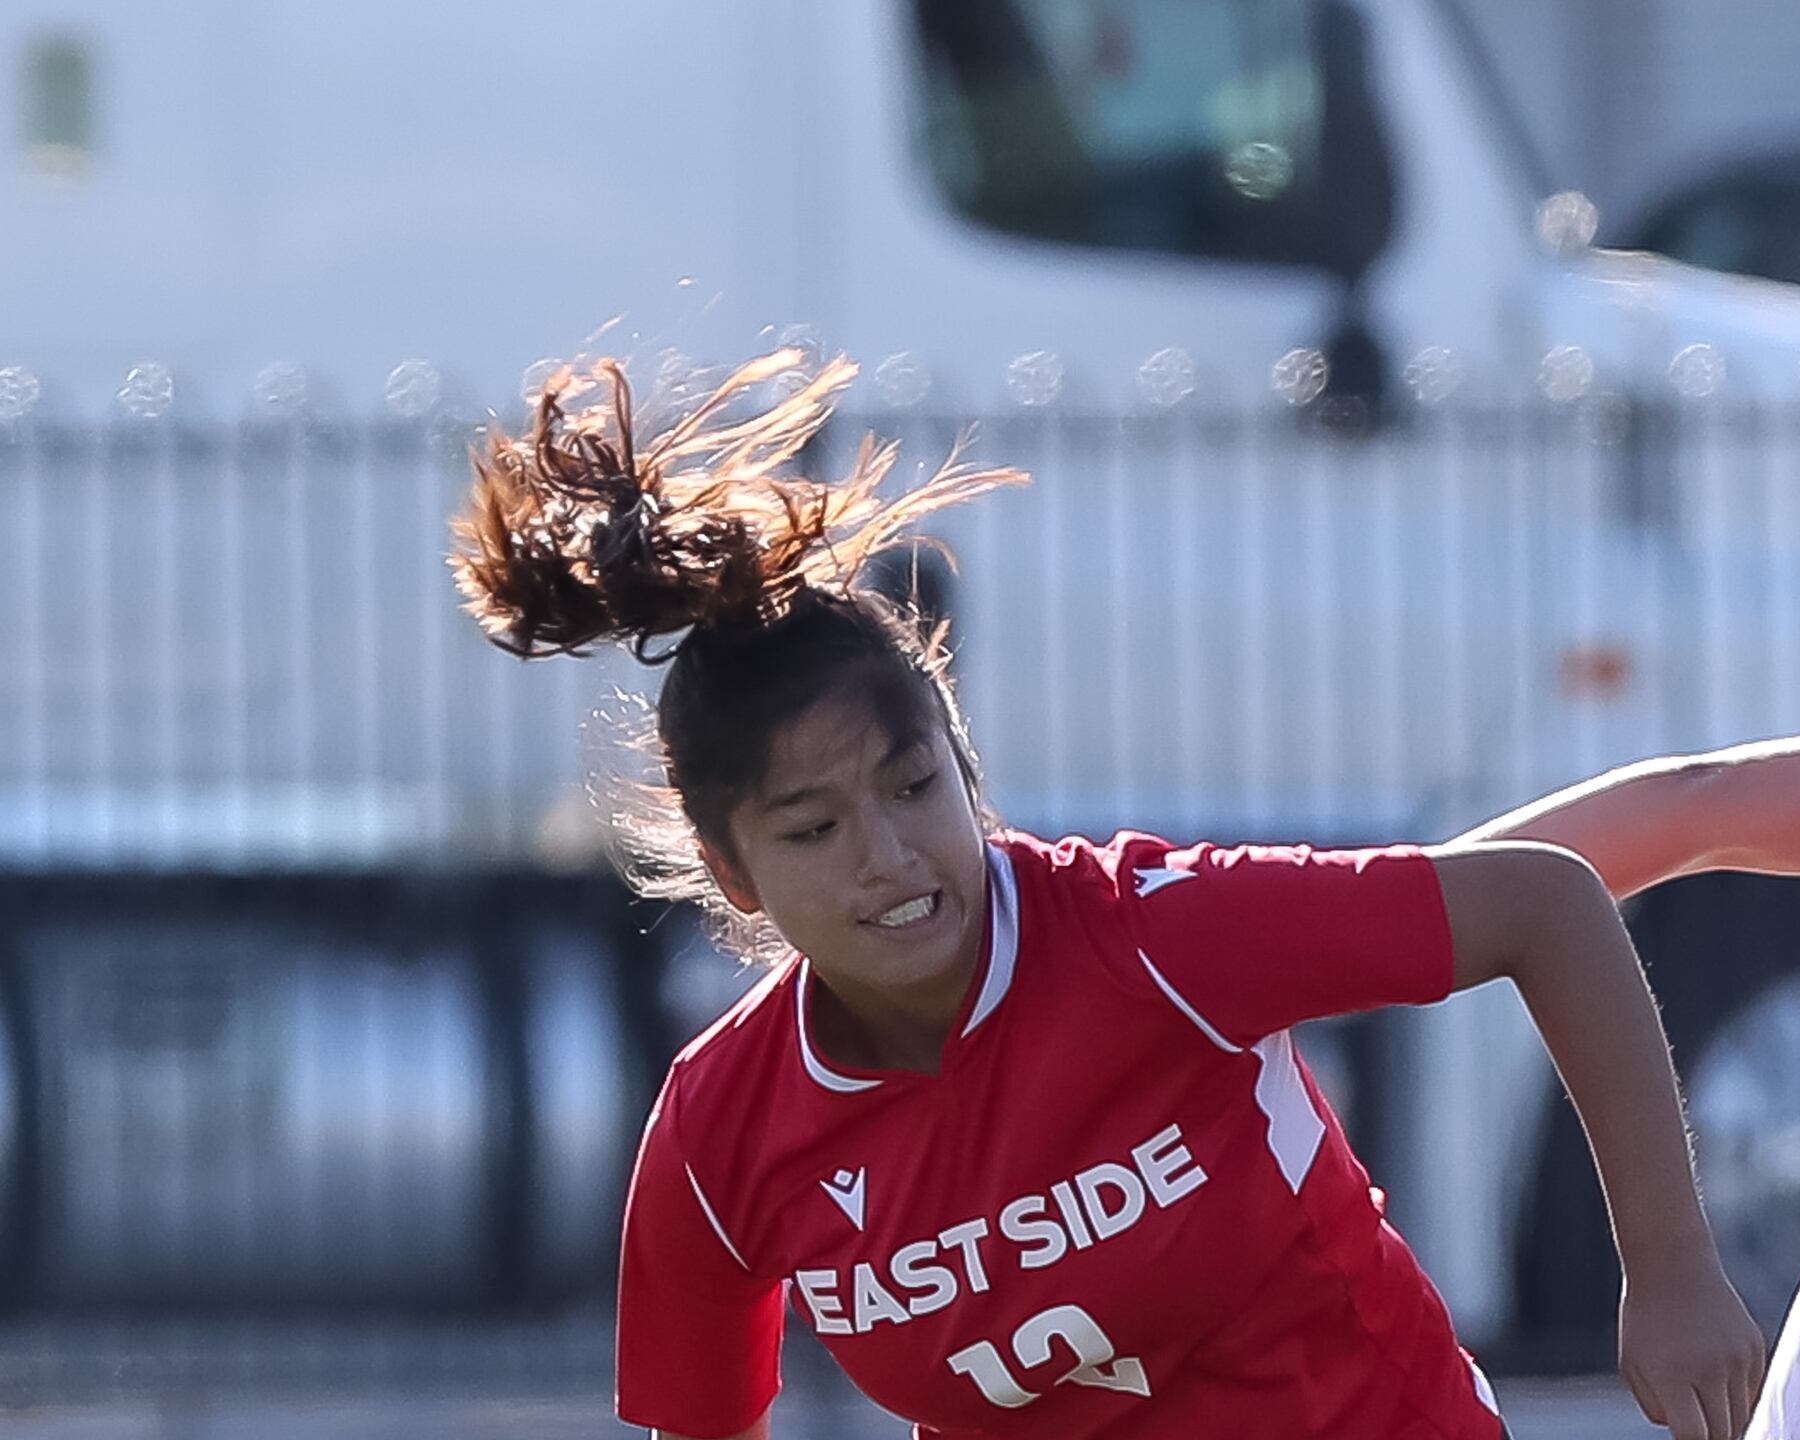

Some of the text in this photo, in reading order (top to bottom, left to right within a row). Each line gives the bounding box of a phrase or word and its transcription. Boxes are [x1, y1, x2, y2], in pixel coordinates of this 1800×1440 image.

[796, 1123, 1209, 1335] EAST SIDE
[946, 1304, 1151, 1408] 12
